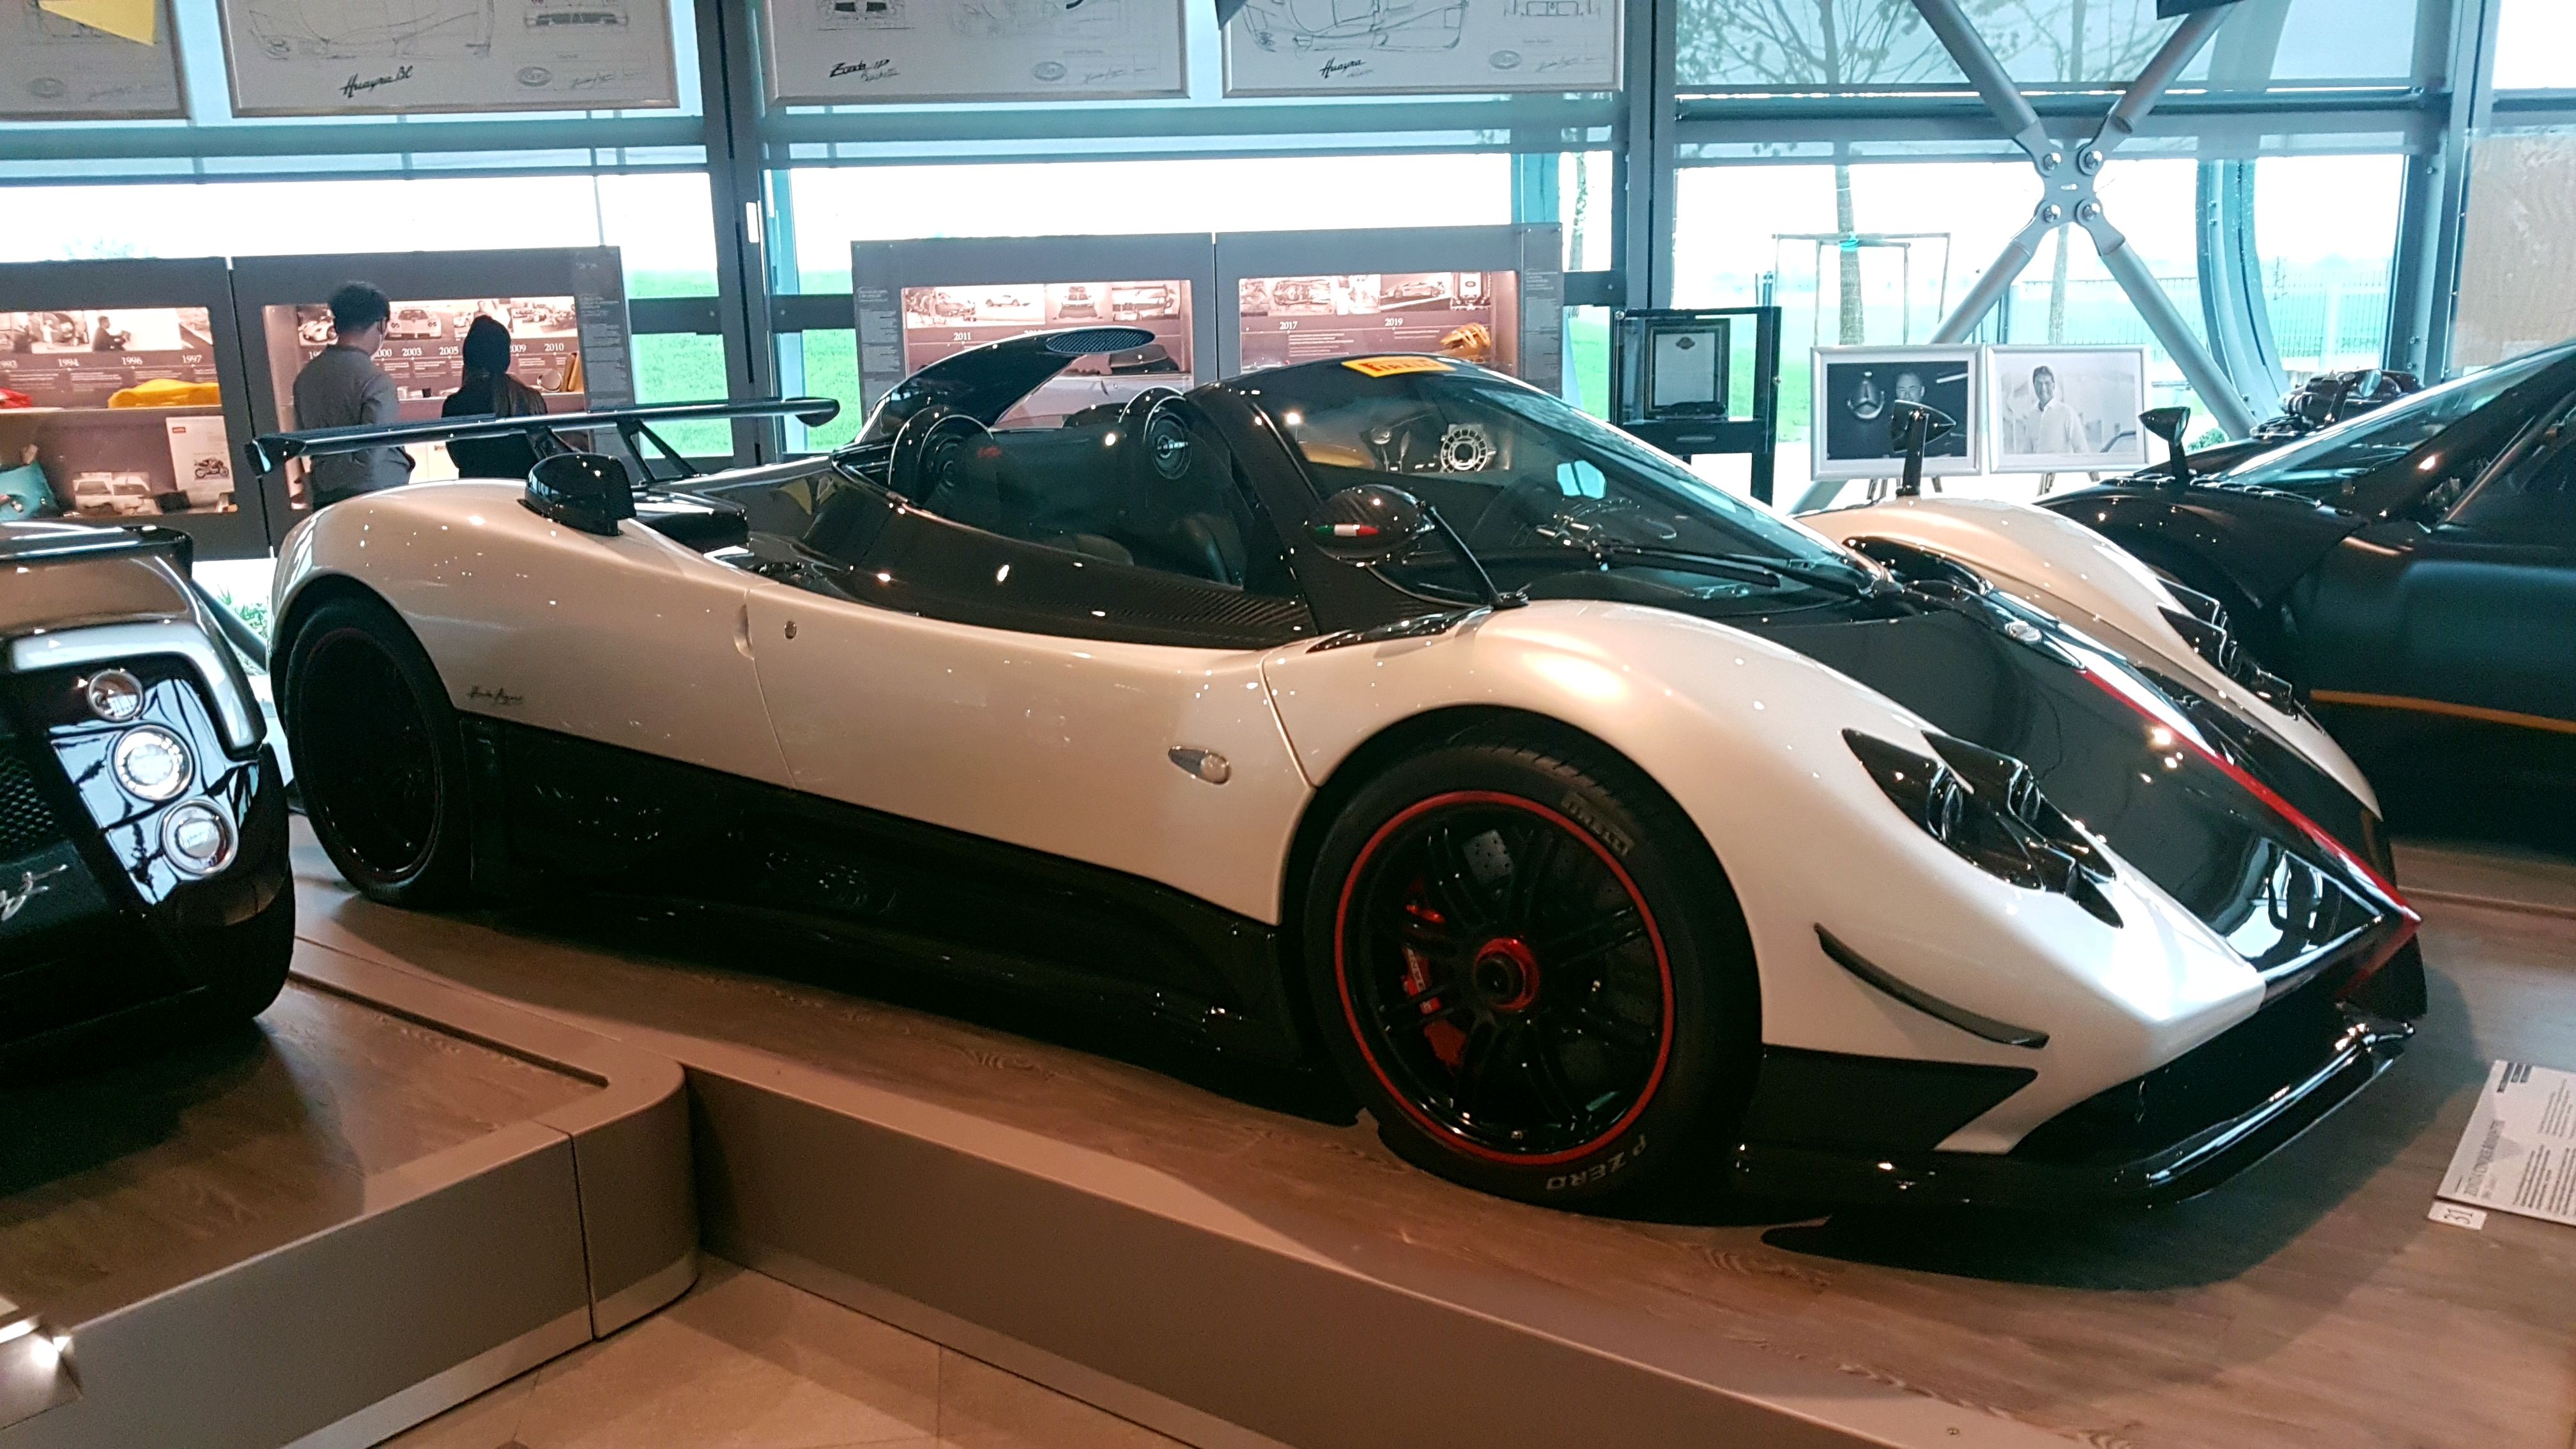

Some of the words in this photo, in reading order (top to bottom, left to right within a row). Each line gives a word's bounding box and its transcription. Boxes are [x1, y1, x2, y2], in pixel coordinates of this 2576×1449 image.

[1319, 57, 1367, 79] Huayra
[1279, 321, 1298, 330] 2017
[1385, 318, 1403, 326] 2019
[953, 332, 971, 341] 2011
[402, 347, 422, 356] 2003
[439, 346, 459, 355] 2005
[544, 343, 564, 351] 2010
[57, 358, 79, 368] 1994
[121, 356, 142, 365] 1996
[181, 354, 203, 364] 1997
[1546, 1151, 1627, 1192] ZERO
[2443, 1207, 2474, 1225] 31
